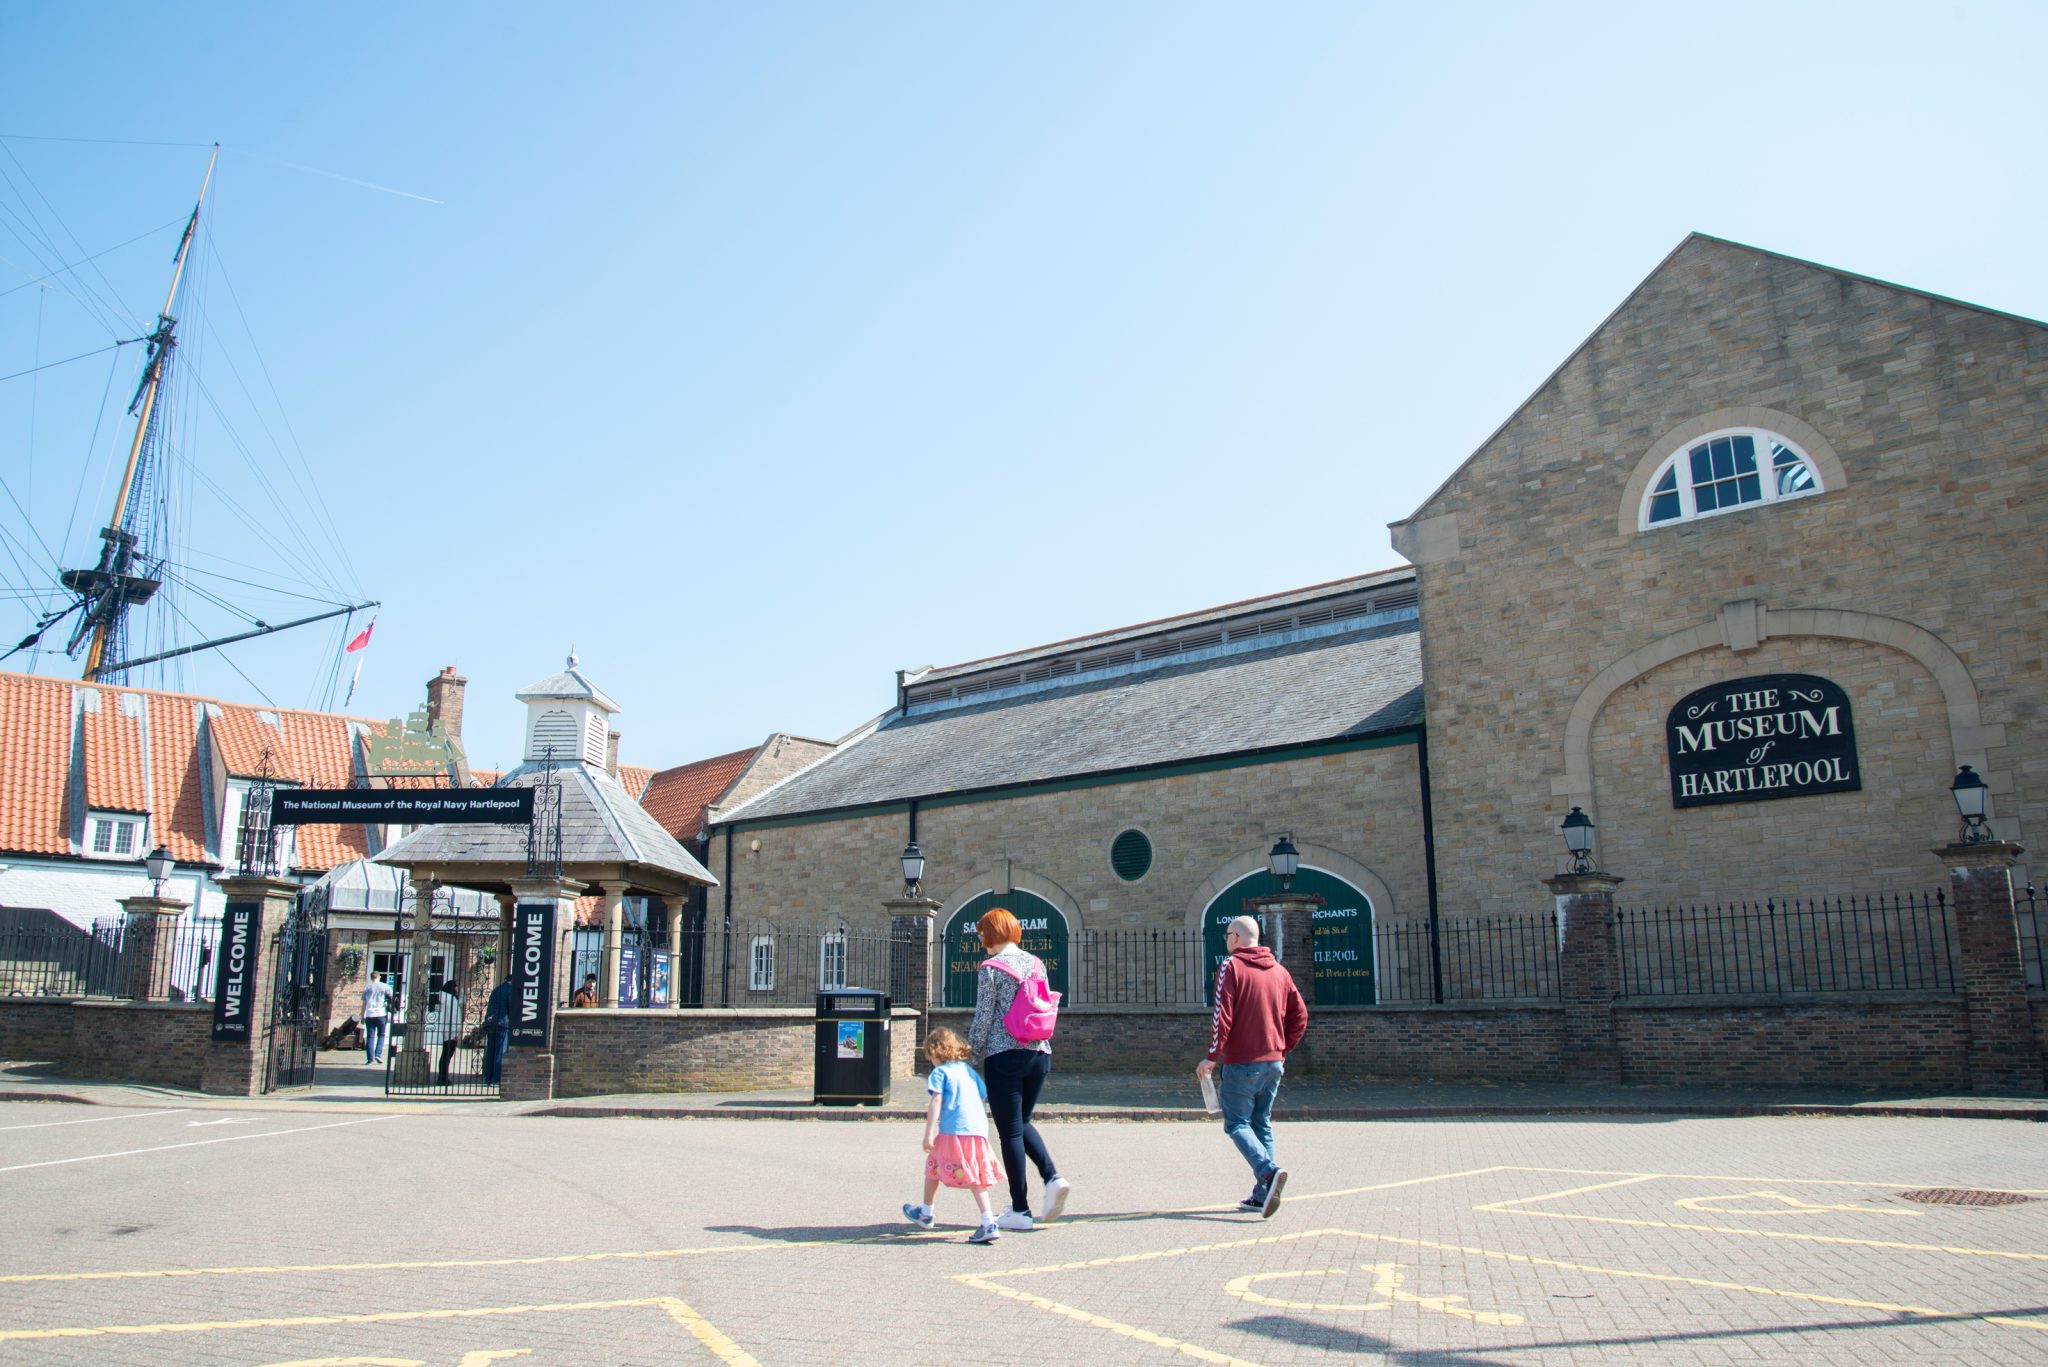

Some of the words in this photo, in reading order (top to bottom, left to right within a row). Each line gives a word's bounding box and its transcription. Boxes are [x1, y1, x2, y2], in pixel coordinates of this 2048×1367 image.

[1726, 688, 1780, 713] THE
[1675, 706, 1843, 754] MUSEUM
[1746, 741, 1775, 765] of
[1679, 757, 1850, 797] HARTLEPOOL
[283, 800, 299, 809] The
[301, 800, 340, 809] National
[342, 800, 382, 809] Museum
[384, 800, 395, 809] of
[397, 800, 412, 809] the
[414, 800, 441, 811] Royal
[443, 800, 467, 810] Navy
[469, 799, 520, 810] Hartlepool
[1311, 908, 1358, 919] RCHANTS
[225, 912, 249, 1017] WELCOME
[522, 913, 543, 1022] WELCOME
